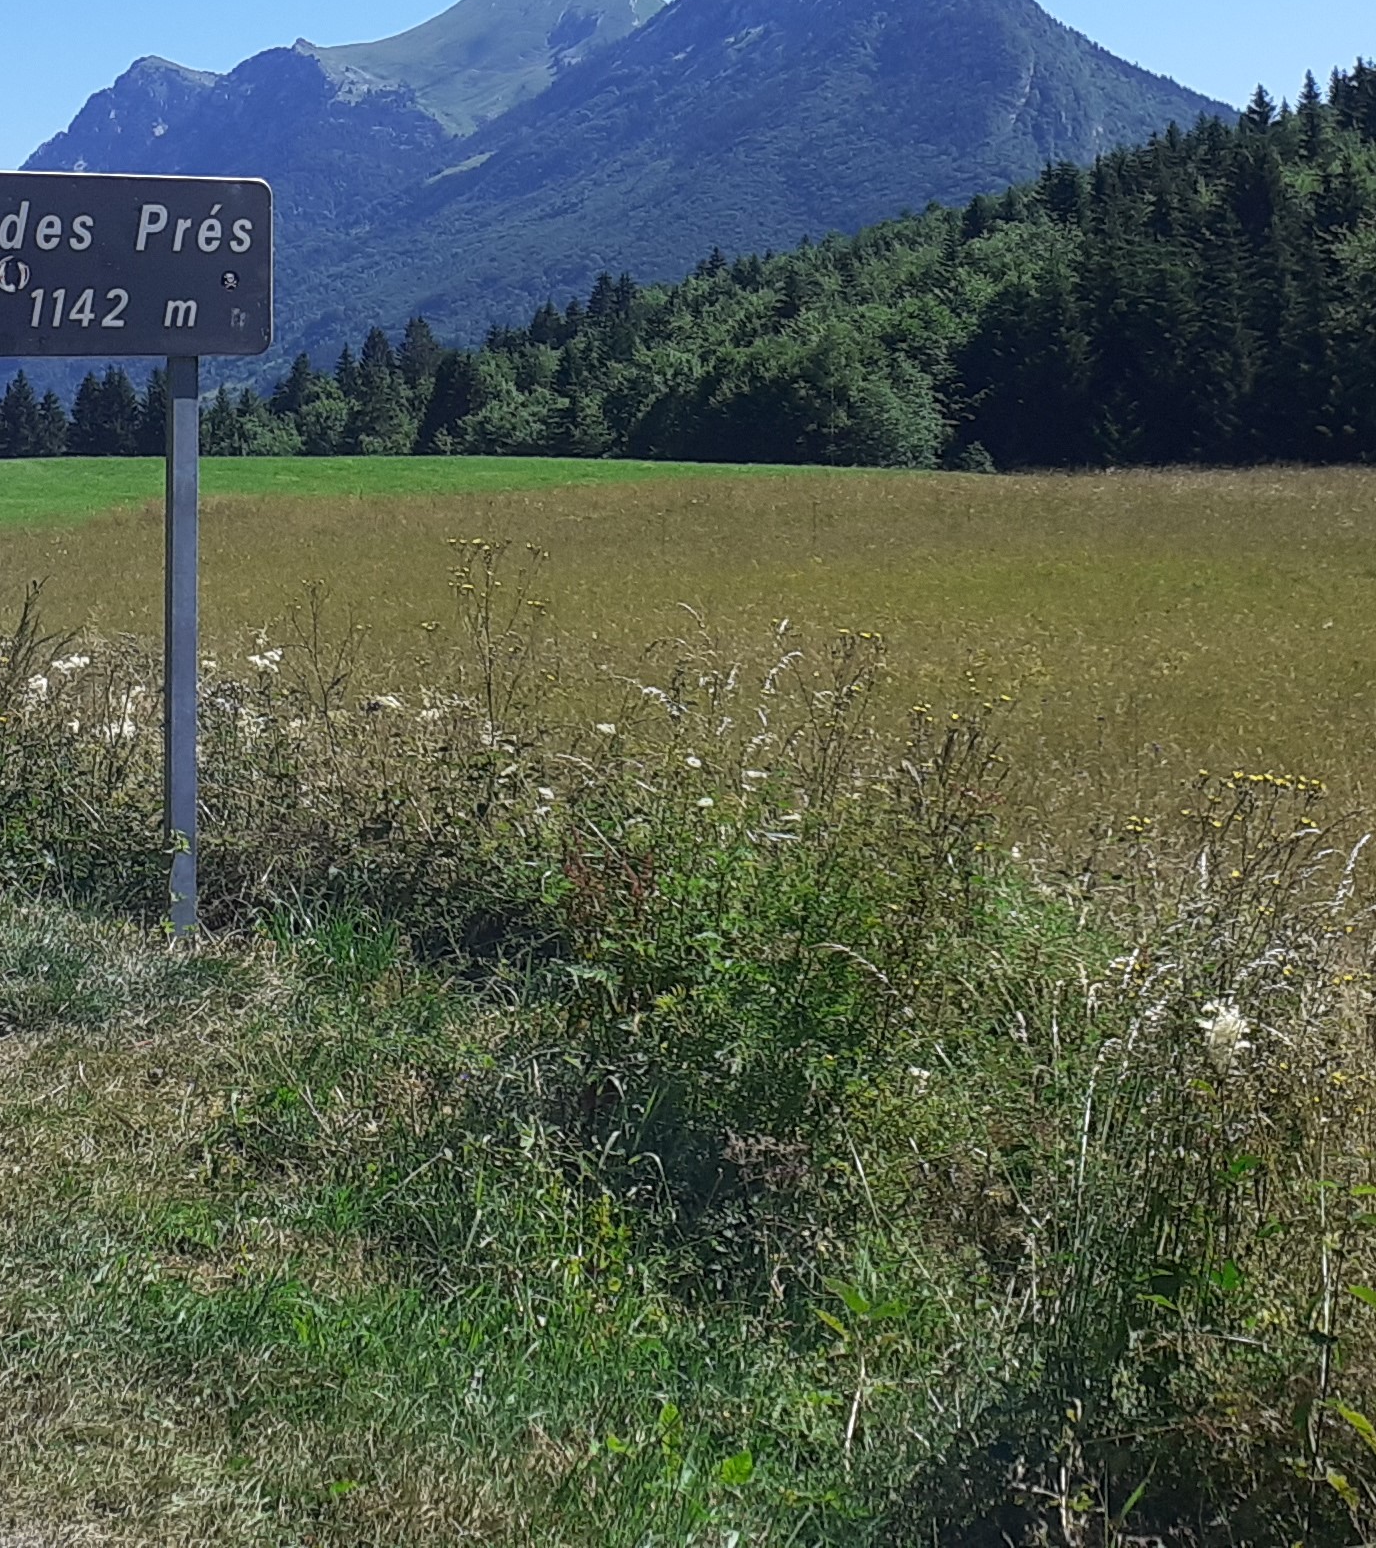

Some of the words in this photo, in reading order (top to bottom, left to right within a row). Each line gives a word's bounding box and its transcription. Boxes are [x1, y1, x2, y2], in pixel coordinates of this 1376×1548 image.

[136, 204, 253, 253] Prés
[30, 288, 130, 328] 1142
[164, 298, 197, 328] m
